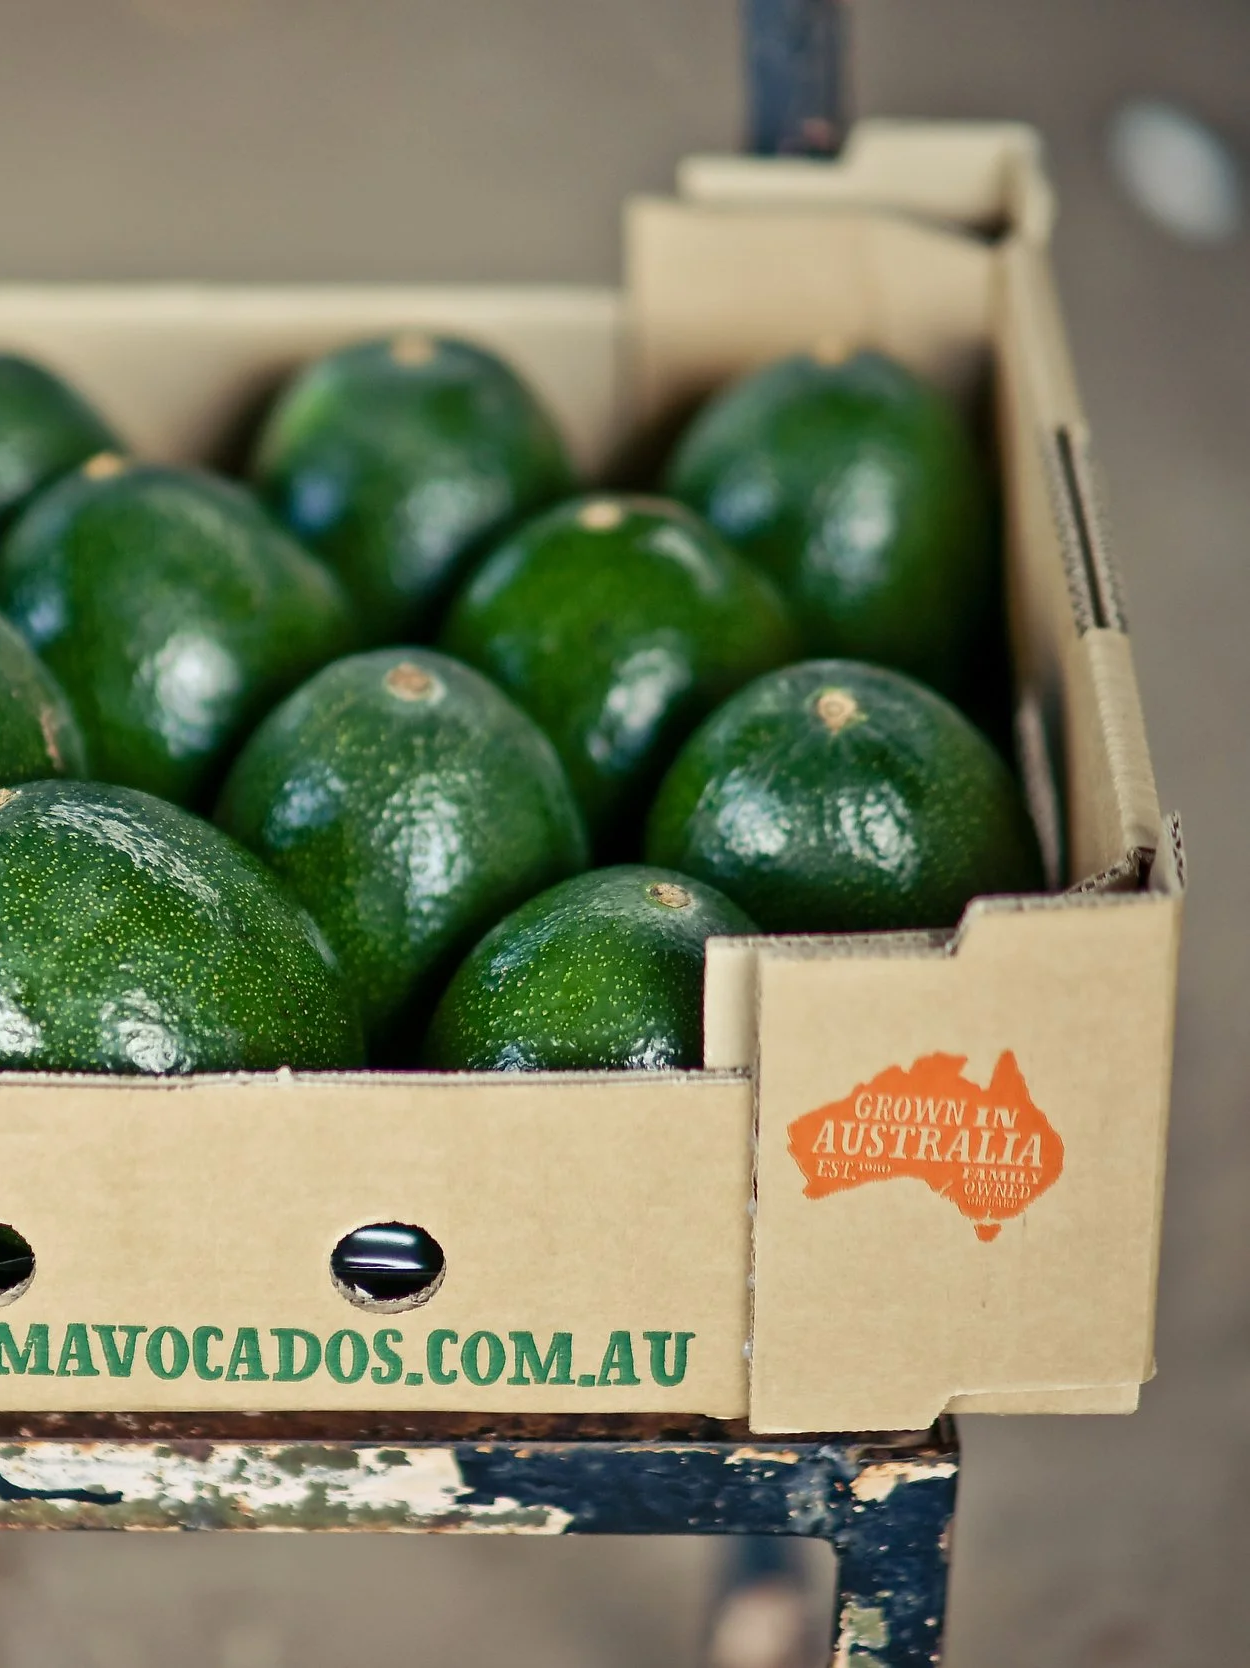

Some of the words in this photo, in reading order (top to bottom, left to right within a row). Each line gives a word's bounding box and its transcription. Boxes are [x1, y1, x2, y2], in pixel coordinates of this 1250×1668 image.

[854, 1092, 967, 1127] GROWN
[973, 1106, 1020, 1128] IN
[811, 1119, 1043, 1168] AUSTRALIA
[816, 1159, 857, 1181] EST.
[961, 1166, 1042, 1185] FAMILY
[963, 1181, 1031, 1200] OWNED
